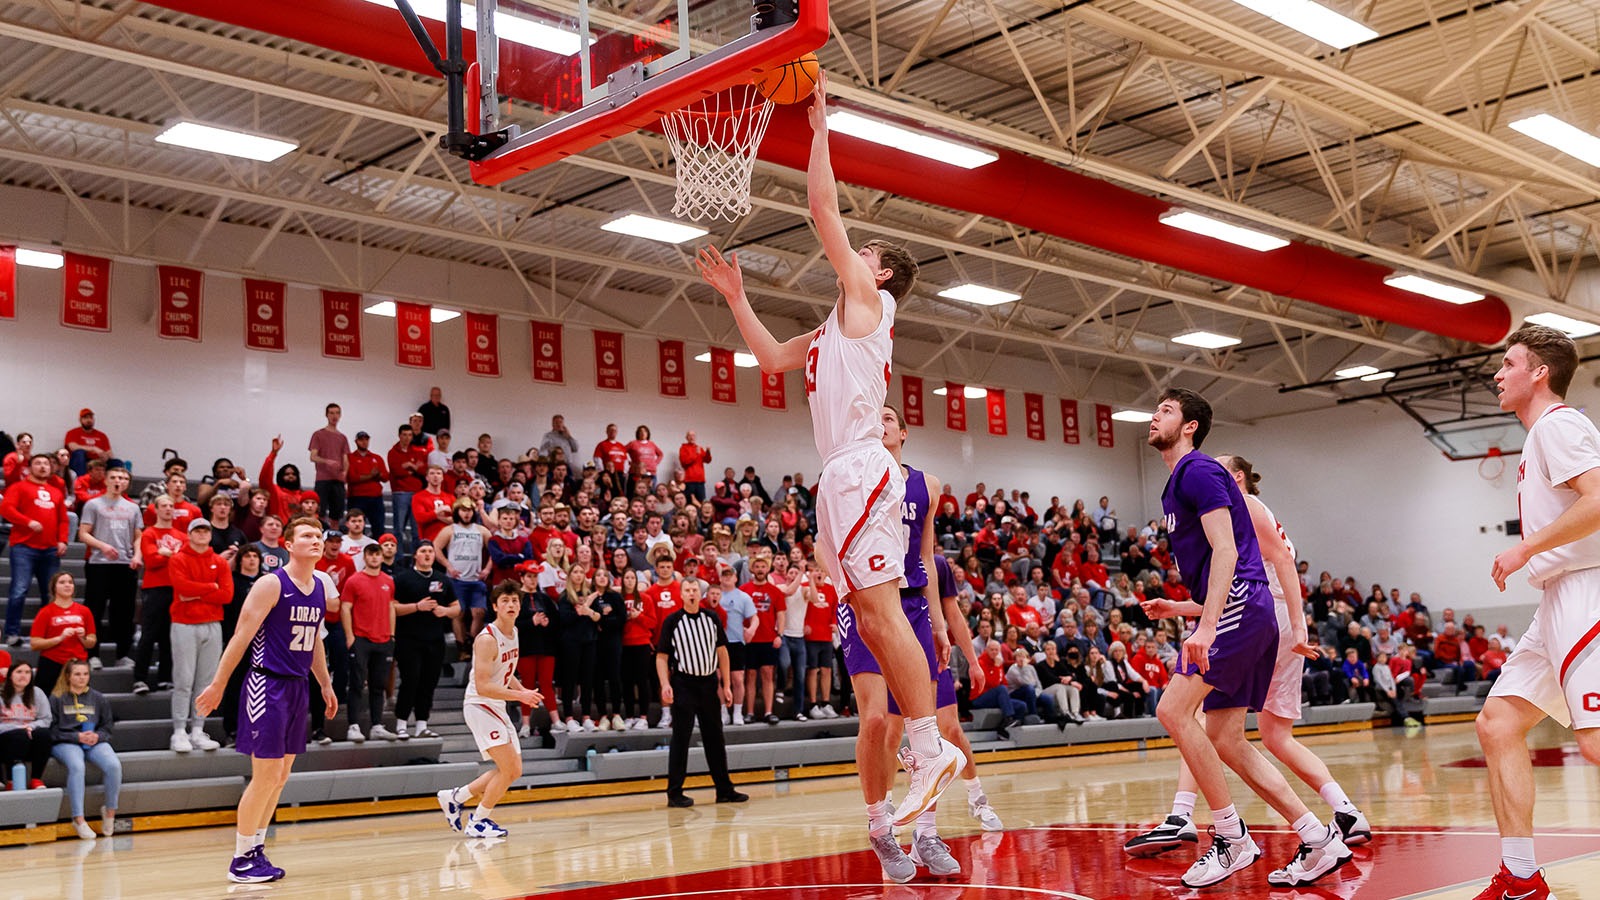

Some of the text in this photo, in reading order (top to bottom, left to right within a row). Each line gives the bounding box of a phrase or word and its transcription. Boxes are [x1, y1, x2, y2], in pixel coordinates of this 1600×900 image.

[75, 264, 99, 277] IIAC
[169, 276, 191, 288] IIAC
[255, 290, 275, 301] IIAC
[70, 299, 102, 313] CHAMPS
[331, 300, 350, 311] IIAC
[165, 311, 194, 323] CHAMPS
[405, 311, 423, 321] IIAC
[251, 323, 280, 335] CHAMPS
[328, 332, 356, 343] CHAMPS
[401, 342, 427, 353] CHAMPS
[471, 351, 495, 362] CHAMPS
[536, 359, 559, 370] CHAMPS
[599, 368, 620, 377] CHAMPS
[868, 554, 886, 571] C
[289, 605, 321, 623] LORAS
[289, 624, 317, 652] 20
[501, 648, 519, 663] DUTC
[503, 662, 514, 687] 2
[1582, 692, 1600, 712] C
[490, 731, 500, 740] C
